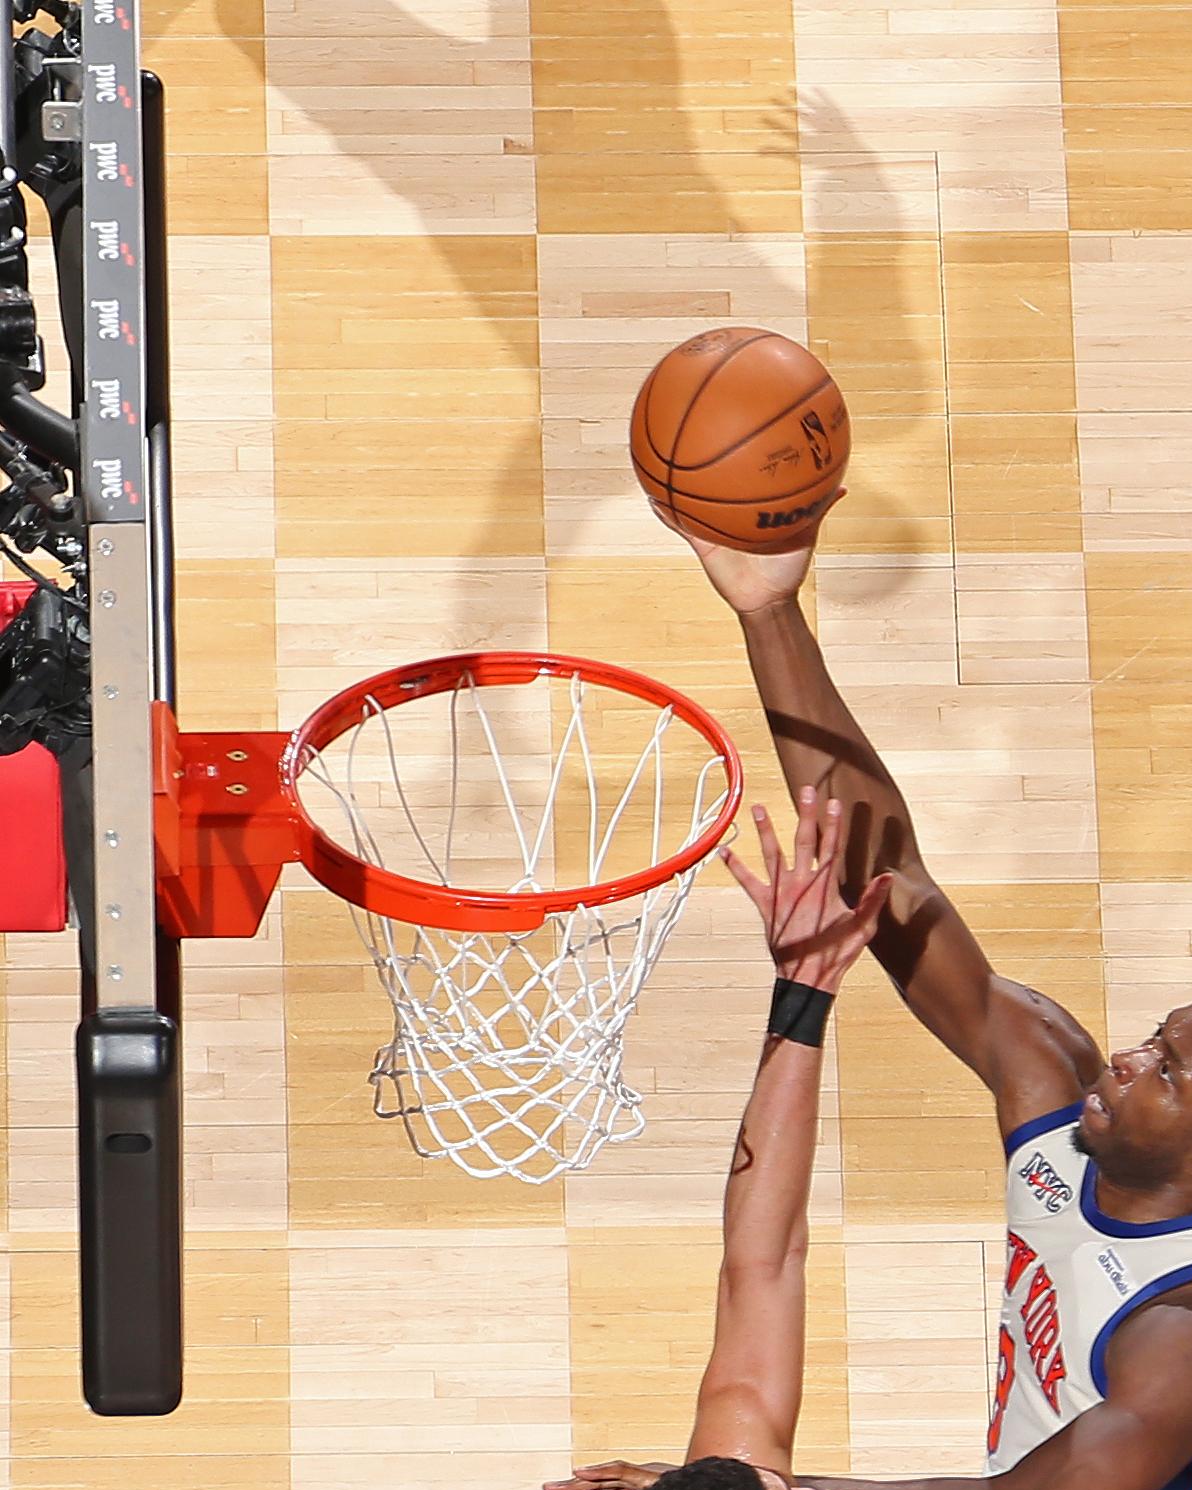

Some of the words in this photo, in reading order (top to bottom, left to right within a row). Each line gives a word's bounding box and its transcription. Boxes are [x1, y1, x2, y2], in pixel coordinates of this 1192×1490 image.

[94, 0, 115, 24] wc
[88, 64, 117, 103] pwc
[90, 142, 118, 181] pwc
[91, 220, 119, 260] pwc
[91, 300, 119, 339] pwc
[92, 378, 120, 419] pwc
[93, 459, 123, 498] pwc
[1018, 1151, 1073, 1213] NYC
